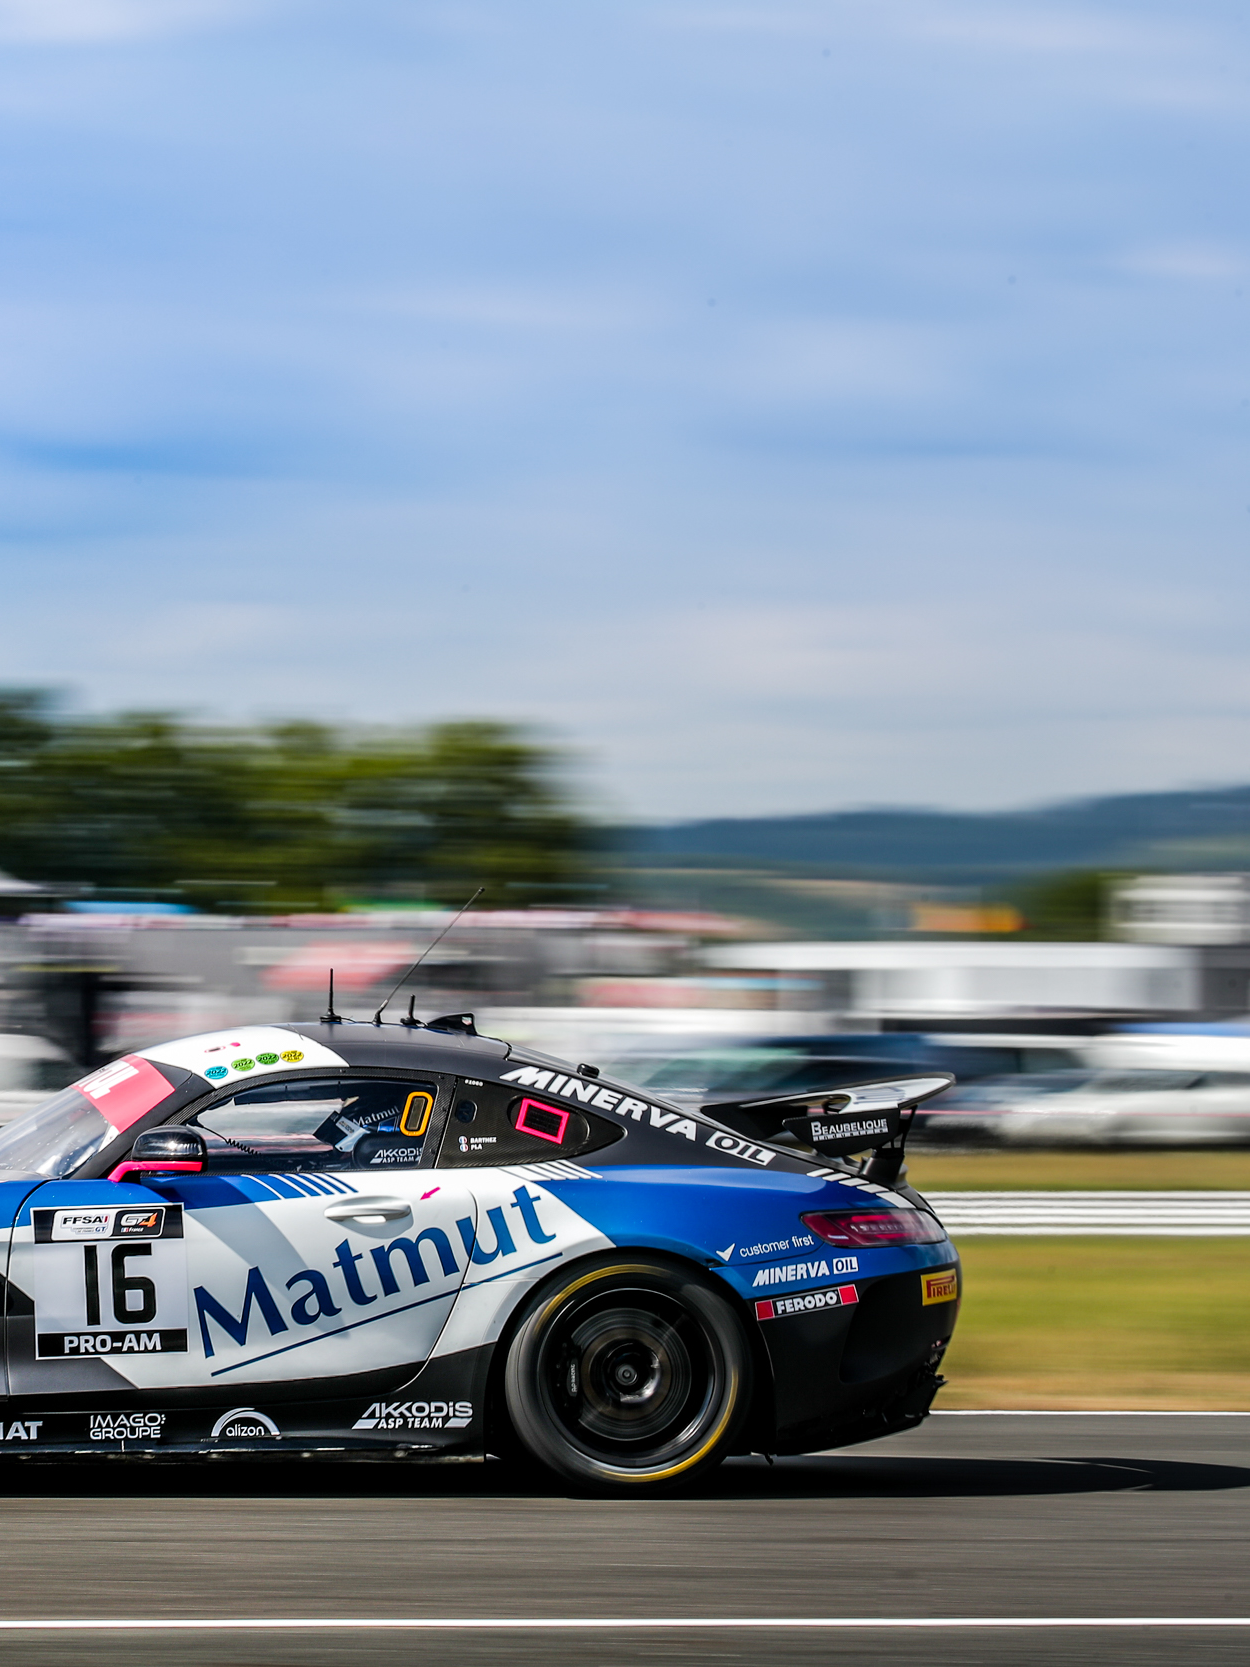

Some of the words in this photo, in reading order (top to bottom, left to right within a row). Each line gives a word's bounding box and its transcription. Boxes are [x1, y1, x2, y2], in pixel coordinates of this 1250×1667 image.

[499, 1065, 698, 1142] MINERVA
[713, 1134, 770, 1163] OIL
[470, 1143, 483, 1151] PLA
[121, 1212, 158, 1227] GT4
[739, 1239, 790, 1258] customer
[791, 1234, 815, 1248] first
[83, 1242, 157, 1326] 16
[193, 1185, 557, 1359] Matmut
[752, 1260, 830, 1287] MINERVA
[834, 1258, 858, 1272] OIL
[925, 1274, 956, 1299] PIRELLI
[776, 1291, 838, 1315] FERODO
[63, 1332, 162, 1354] PRO-AM
[90, 1426, 161, 1440] GROUPE
[226, 1424, 265, 1437] alizon
[377, 1418, 404, 1429] ASP
[407, 1417, 443, 1429] TEAM
